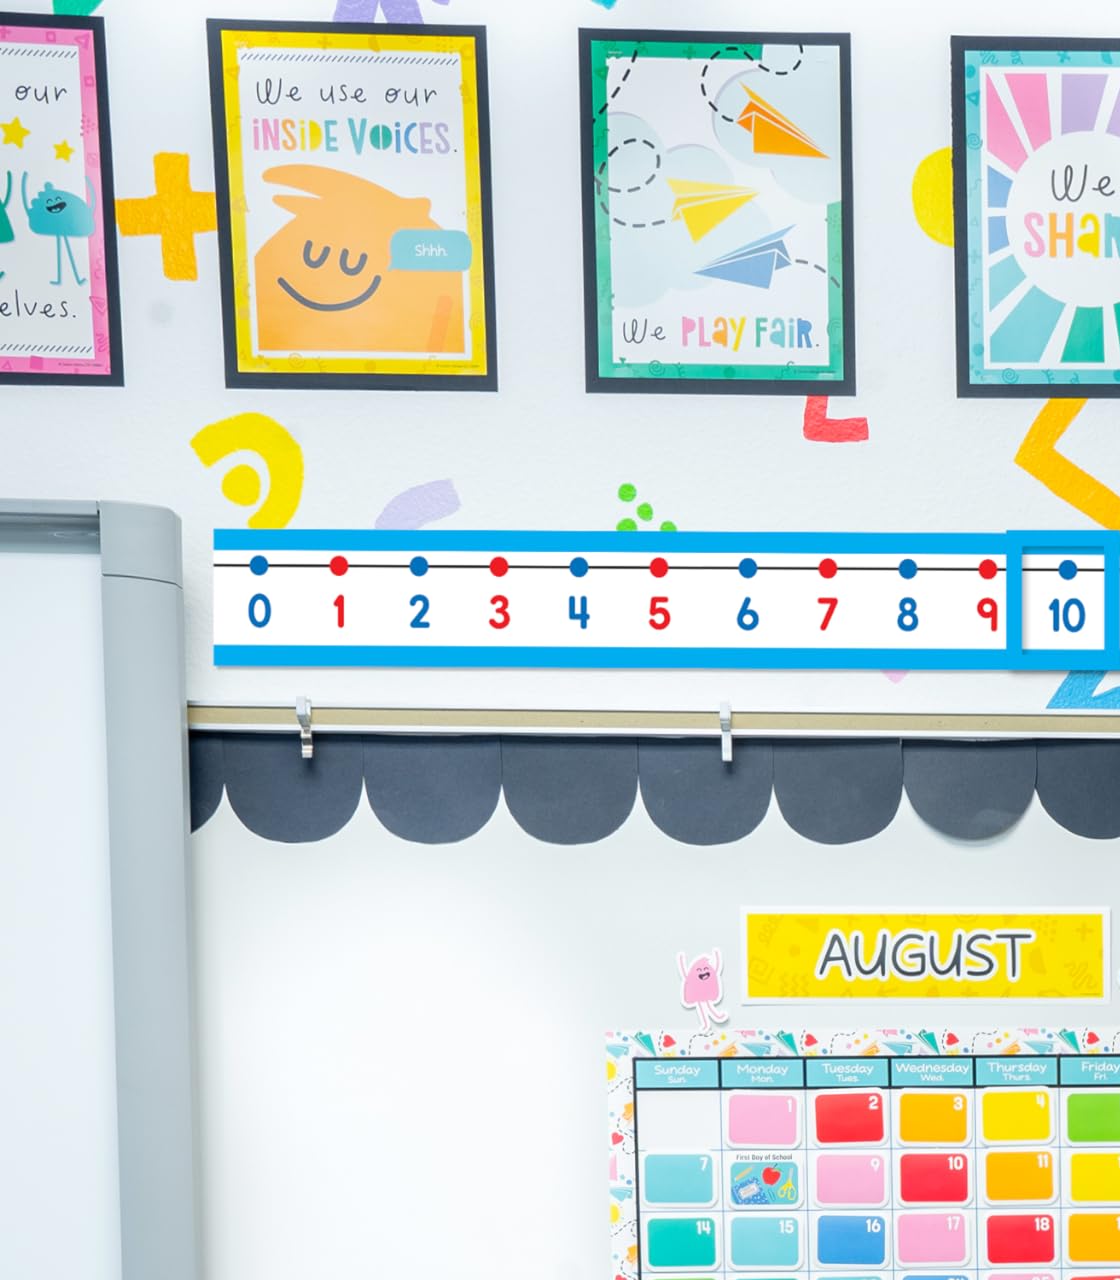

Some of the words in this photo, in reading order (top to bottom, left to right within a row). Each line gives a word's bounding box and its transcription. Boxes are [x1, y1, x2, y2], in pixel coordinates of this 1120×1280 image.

[15, 83, 68, 104] our
[256, 77, 302, 104] We
[319, 84, 367, 104] use
[384, 86, 437, 106] our
[1050, 163, 1115, 202] We
[622, 317, 666, 344] We
[248, 593, 272, 628] 0
[333, 594, 345, 629] 1
[409, 594, 430, 629] 2
[488, 594, 511, 630] 3
[568, 596, 590, 630] 4
[648, 596, 671, 631] 5
[737, 596, 759, 631] 6
[817, 597, 839, 631] 7
[897, 597, 919, 632] 8
[976, 596, 1000, 633] 9
[1049, 598, 1086, 633] 10
[818, 931, 1034, 979] AUGUST
[654, 1064, 702, 1077] Sunday
[736, 1064, 789, 1076] Monday
[821, 1063, 874, 1075] Tuesday
[895, 1062, 970, 1075] Wednesday
[986, 1061, 1048, 1075] Thursday
[1081, 1061, 1120, 1074] Friday
[787, 1099, 793, 1113] 1
[868, 1096, 879, 1111] 2
[953, 1097, 964, 1110] 3
[1036, 1094, 1046, 1108] 4
[699, 1157, 709, 1172] 7
[870, 1158, 881, 1171] 9
[948, 1156, 964, 1171] 10
[1037, 1154, 1049, 1168] 11
[750, 1154, 764, 1162] Day
[772, 1153, 793, 1161] School
[696, 1220, 711, 1235] 14
[779, 1220, 794, 1234] 15
[866, 1219, 881, 1233] 16
[946, 1217, 961, 1231] 17
[1034, 1217, 1050, 1232] 18
